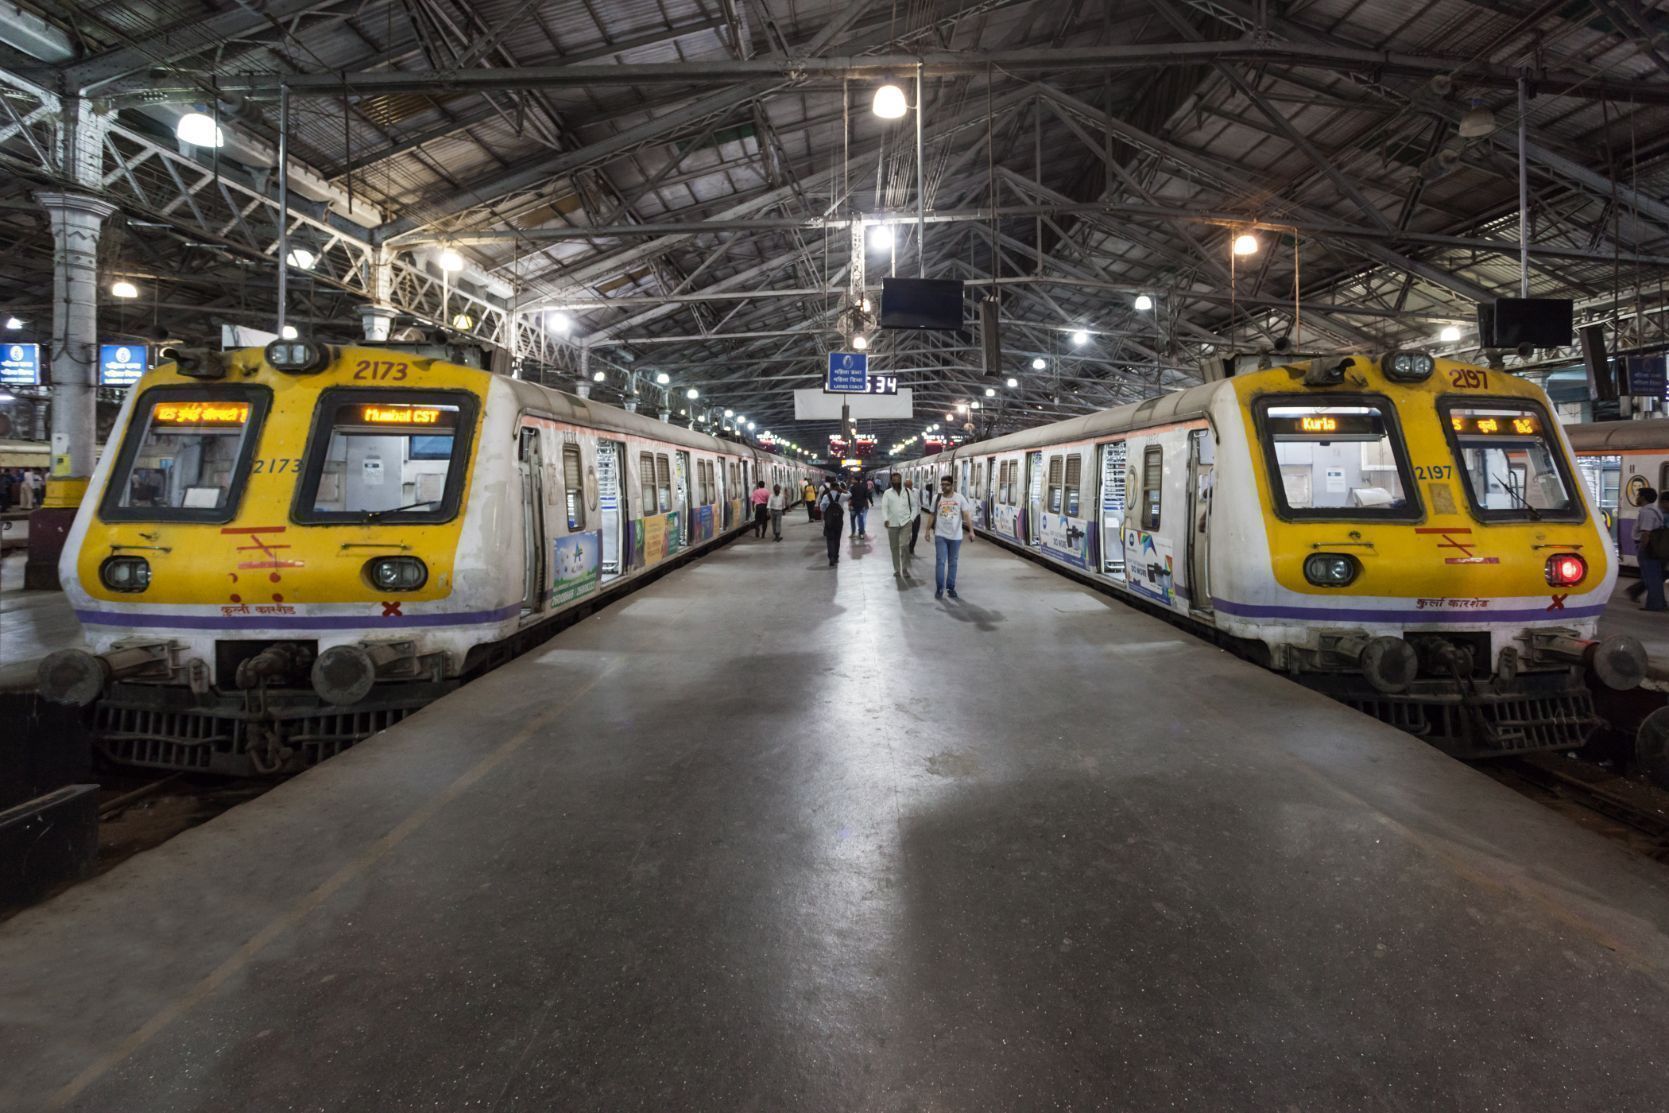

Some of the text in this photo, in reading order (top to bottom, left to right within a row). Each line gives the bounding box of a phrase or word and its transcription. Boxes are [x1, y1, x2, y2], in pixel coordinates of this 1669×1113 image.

[353, 360, 408, 380] 2173
[1449, 369, 1488, 389] 2197
[365, 408, 439, 423] Mumbai CST
[1302, 416, 1336, 430] Kurla
[253, 458, 304, 474] 2173
[1415, 466, 1452, 480] 2197
